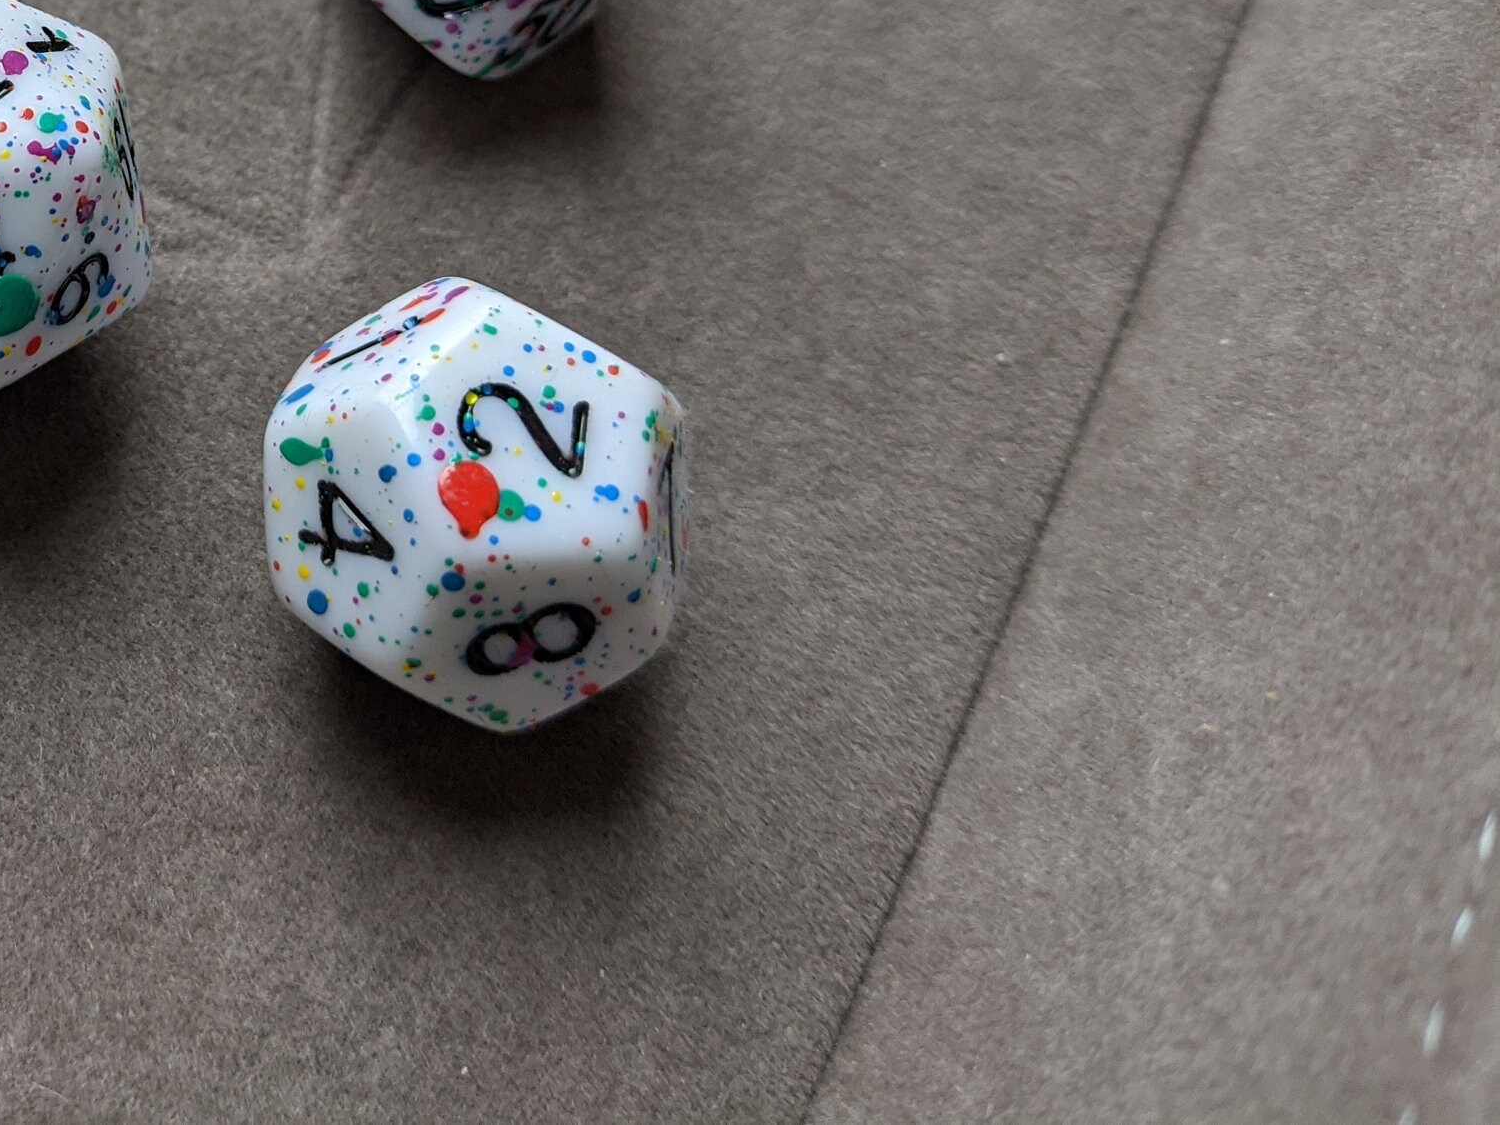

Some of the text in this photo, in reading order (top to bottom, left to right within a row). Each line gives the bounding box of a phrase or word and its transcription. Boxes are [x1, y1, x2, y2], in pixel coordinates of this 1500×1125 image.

[457, 382, 589, 478] 2
[298, 479, 394, 567] 4
[466, 602, 597, 677] 8
